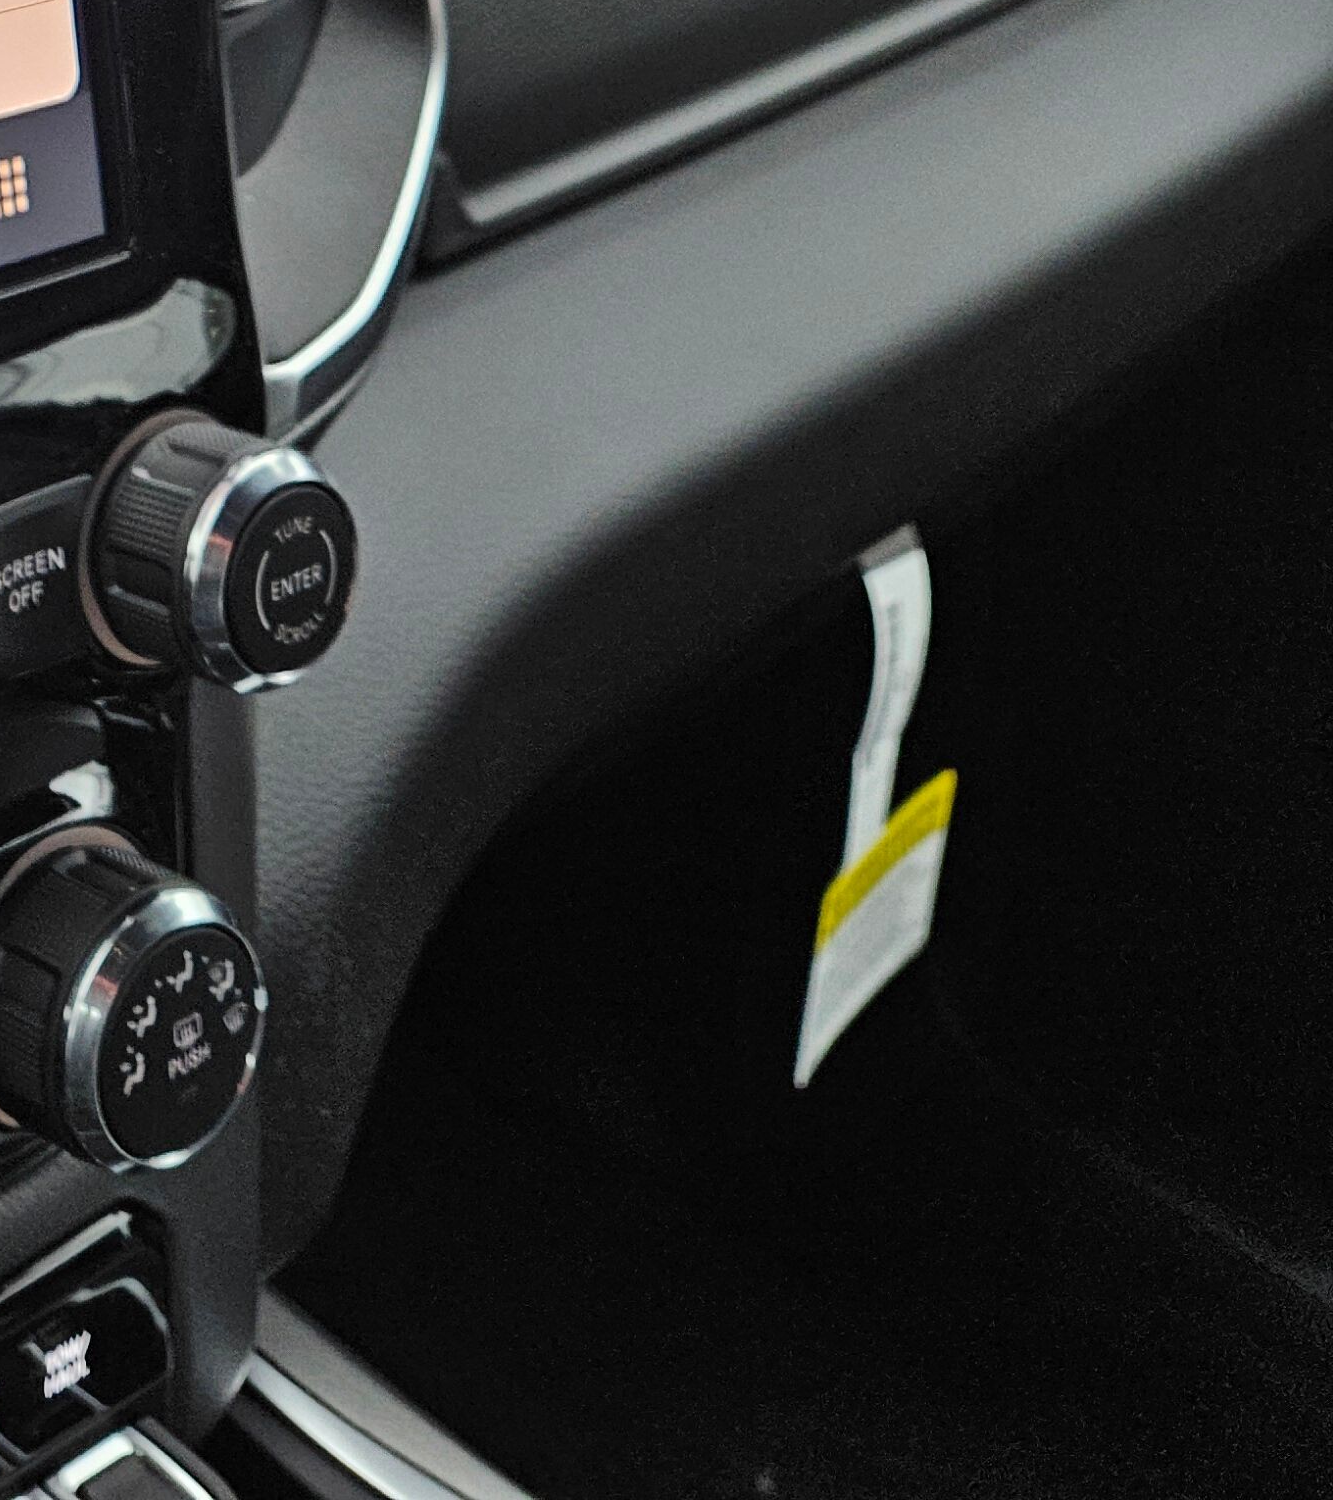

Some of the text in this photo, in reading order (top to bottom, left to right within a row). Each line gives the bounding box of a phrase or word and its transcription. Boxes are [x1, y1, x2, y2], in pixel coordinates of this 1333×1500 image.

[274, 515, 313, 543] TUNE
[8, 581, 45, 613] OFF
[270, 563, 324, 602] ENTER
